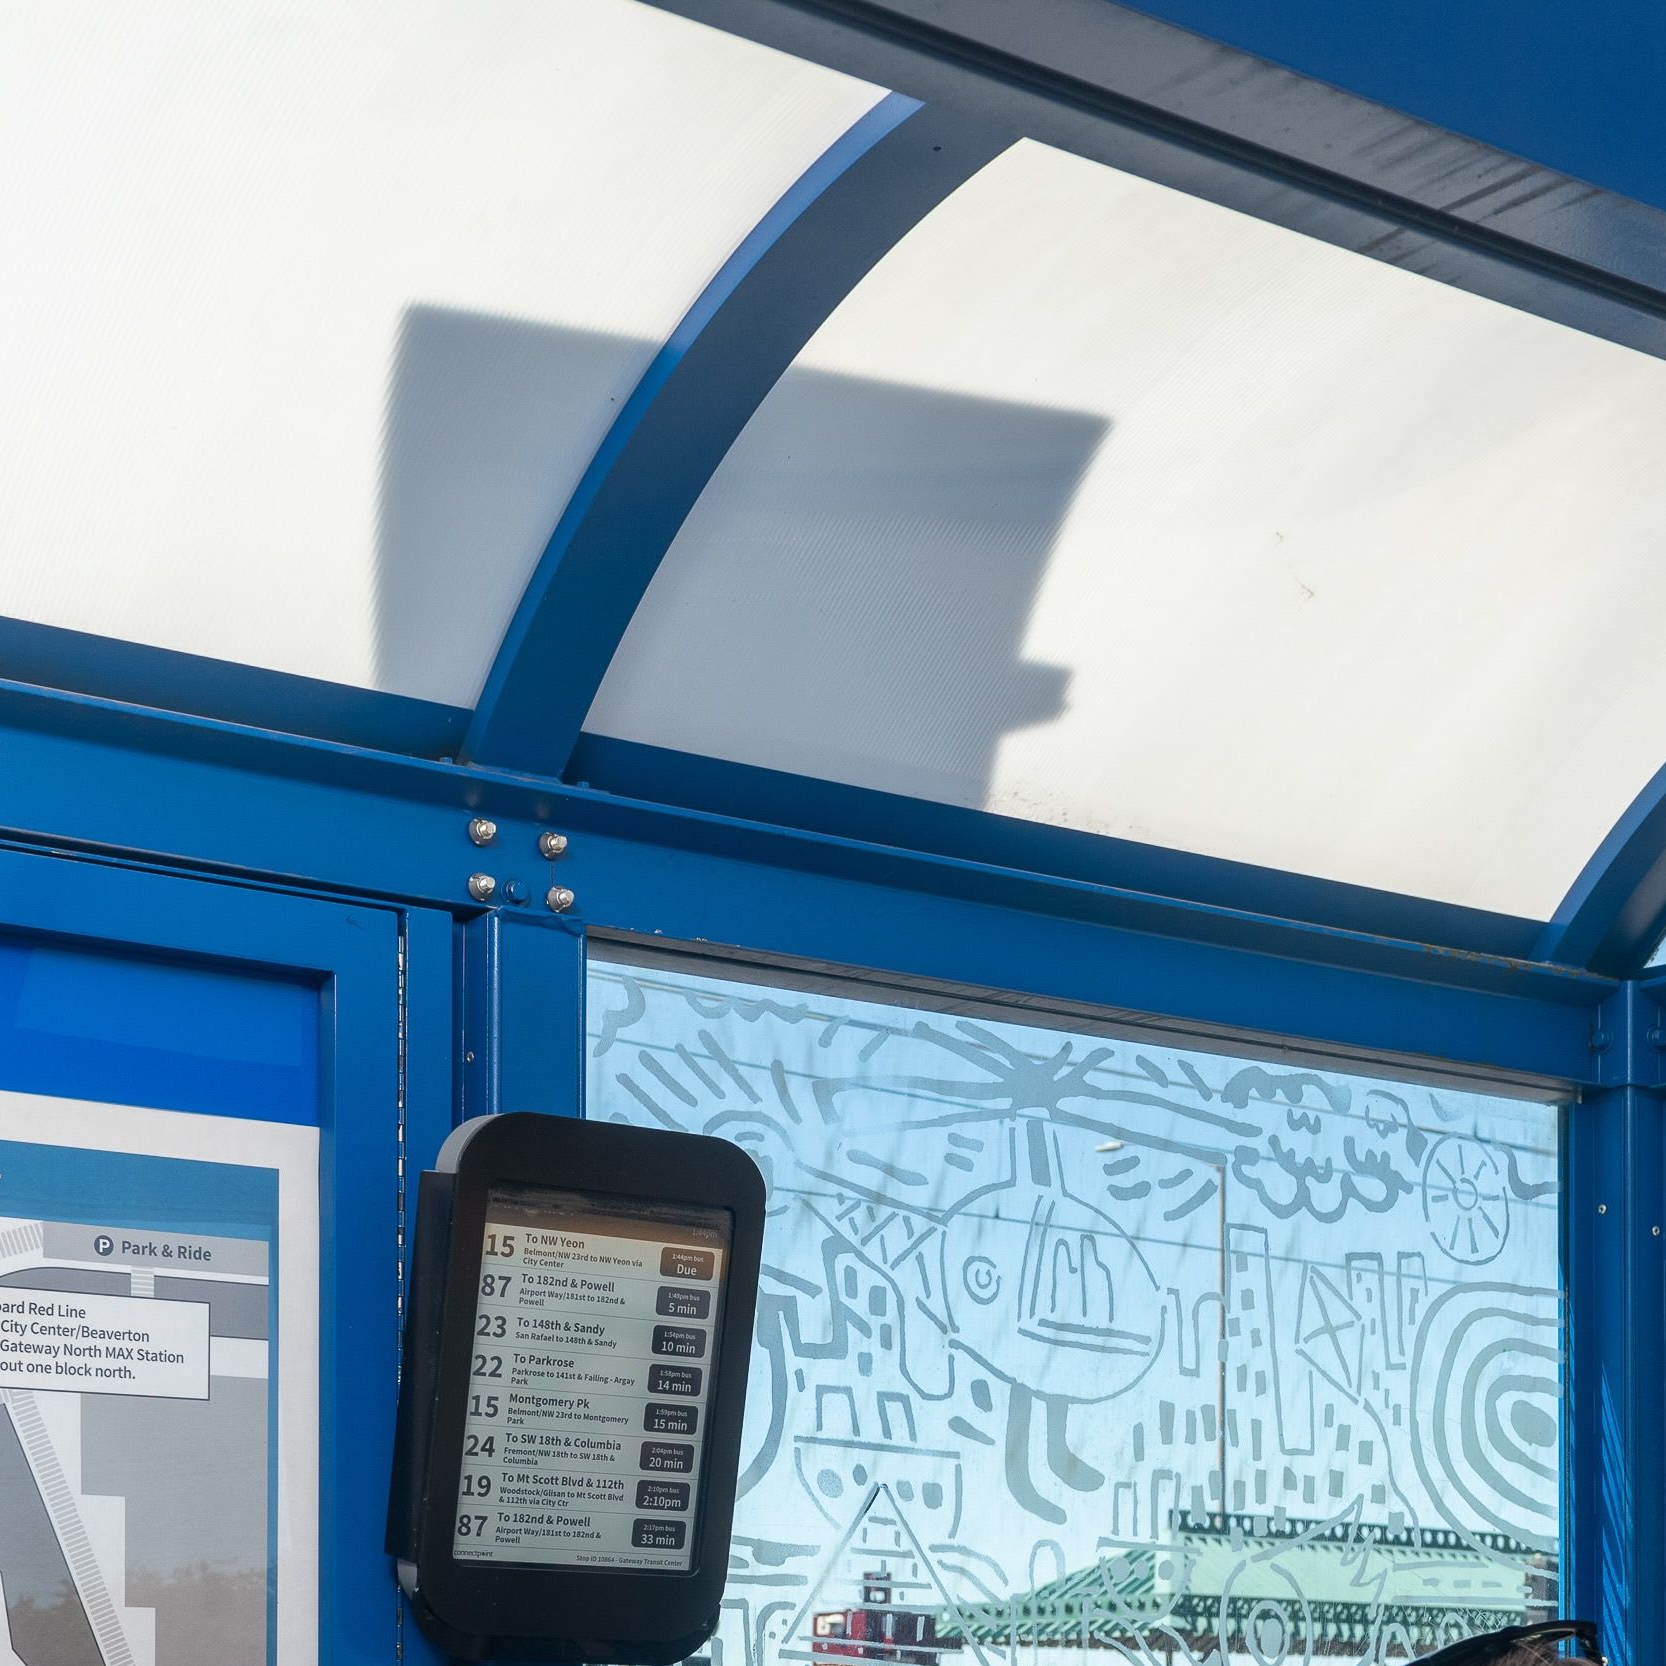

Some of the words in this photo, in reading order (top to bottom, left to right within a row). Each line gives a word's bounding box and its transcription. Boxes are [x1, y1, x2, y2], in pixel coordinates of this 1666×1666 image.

[122, 1241, 158, 1257] Park
[162, 1244, 173, 1258] &
[178, 1245, 212, 1261] Ride
[485, 1234, 515, 1258] 15
[526, 1233, 538, 1244] To
[541, 1235, 558, 1246] NW
[560, 1237, 585, 1249] Yeon
[677, 1264, 697, 1276] Due
[481, 1274, 512, 1298] 87
[522, 1273, 534, 1284] To
[537, 1275, 568, 1287] 182nd
[570, 1279, 578, 1288] &
[581, 1280, 615, 1292] Powell
[29, 1302, 54, 1316] Red
[58, 1305, 86, 1319] Line
[1, 1320, 28, 1337] City
[31, 1322, 149, 1342] Center/Beaverton
[477, 1314, 507, 1338] 23
[517, 1317, 530, 1328] To
[532, 1319, 561, 1331] 148th
[564, 1322, 571, 1332] &
[574, 1323, 605, 1337] Sandy
[0, 1339, 60, 1358] Gateway
[64, 1344, 102, 1358] North
[106, 1347, 134, 1360] MAX
[137, 1349, 184, 1364] Station
[514, 1353, 526, 1364] To
[529, 1355, 574, 1368] Parkrose
[27, 1363, 52, 1374] one
[56, 1362, 92, 1377] block
[96, 1366, 135, 1379] north.
[473, 1355, 503, 1378] 22
[470, 1395, 499, 1418] 15
[510, 1393, 575, 1410] Montgomery
[577, 1399, 589, 1409] Pk
[465, 1435, 495, 1458] 24
[506, 1433, 518, 1443] To
[521, 1434, 537, 1444] SW
[539, 1436, 561, 1446] 18th
[564, 1437, 572, 1447] &
[574, 1438, 621, 1451] Columbia
[462, 1475, 491, 1497] 19
[502, 1473, 514, 1482] To
[517, 1473, 530, 1484] Mt
[532, 1475, 559, 1486] Scott
[561, 1476, 584, 1487] Blvd
[586, 1478, 594, 1488] &
[596, 1479, 624, 1490] 112th
[457, 1514, 488, 1537] 87
[498, 1512, 510, 1522] To
[513, 1514, 544, 1524] 182nd
[546, 1515, 554, 1525] &
[556, 1516, 590, 1527] Powell
